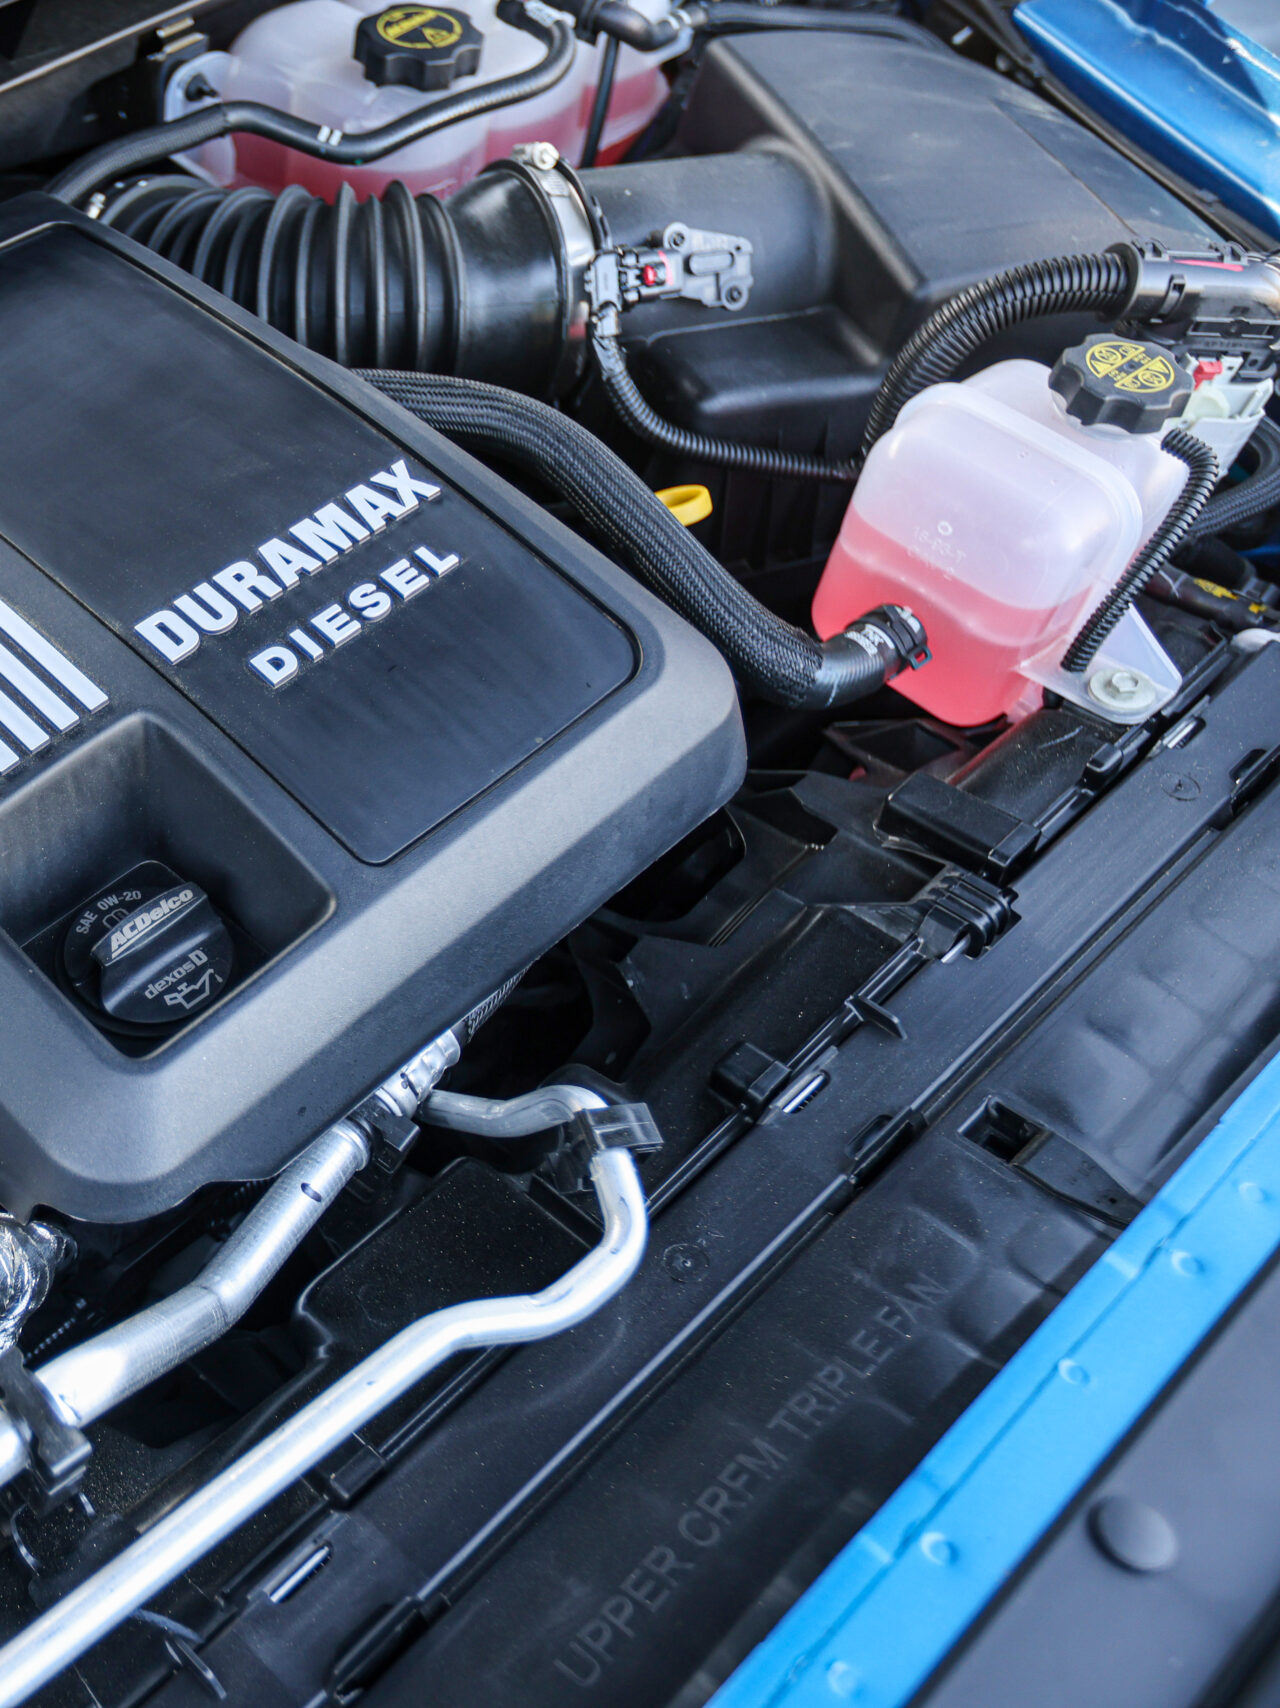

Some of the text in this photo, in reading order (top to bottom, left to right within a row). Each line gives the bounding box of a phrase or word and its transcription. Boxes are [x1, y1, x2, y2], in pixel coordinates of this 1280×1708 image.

[134, 459, 442, 665] DURAMAX
[248, 546, 461, 689] DIESEL
[75, 890, 142, 935] SAE 0W-20
[110, 889, 194, 953] ACDelco
[553, 1271, 950, 1689] UPPER CRFM TRIPLE FAN
